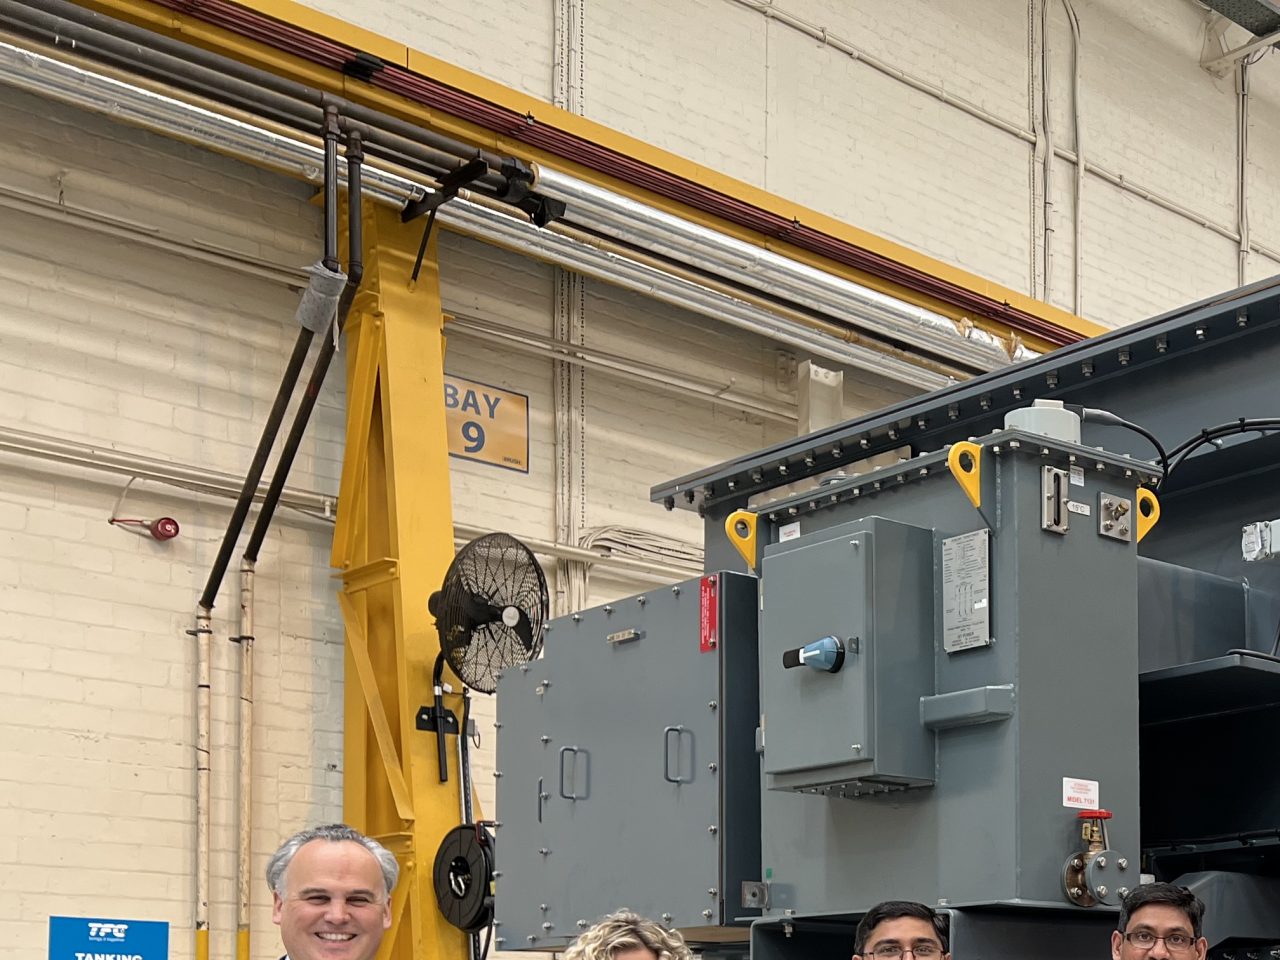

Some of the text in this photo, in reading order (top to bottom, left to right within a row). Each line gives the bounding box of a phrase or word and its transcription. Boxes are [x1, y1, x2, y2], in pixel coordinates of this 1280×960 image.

[444, 383, 501, 419] BAY
[461, 421, 485, 453] 9
[88, 922, 128, 938] TFC
